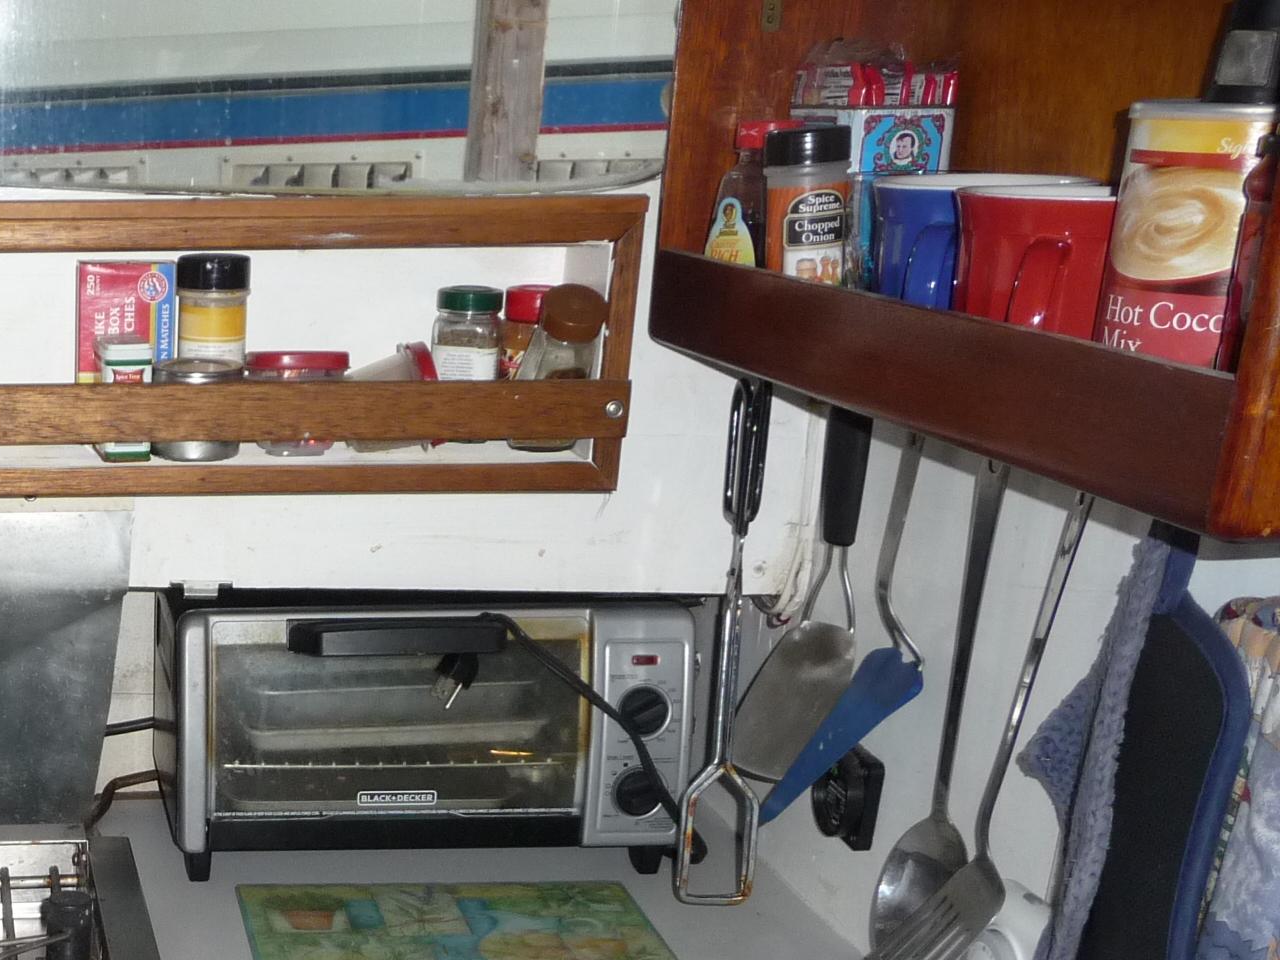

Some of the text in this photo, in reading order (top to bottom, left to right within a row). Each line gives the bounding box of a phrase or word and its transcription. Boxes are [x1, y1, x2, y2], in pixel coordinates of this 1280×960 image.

[799, 201, 841, 213] Supreme
[807, 194, 835, 205] Spice
[795, 216, 840, 233] Chopped
[802, 231, 835, 243] Onion
[87, 275, 95, 296] 250
[124, 296, 136, 333] CHES
[1106, 294, 1225, 333] Hot Coco
[160, 303, 170, 349] MATCHES
[1102, 326, 1142, 351] Mix
[360, 794, 433, 802] BLACK+DECKER
